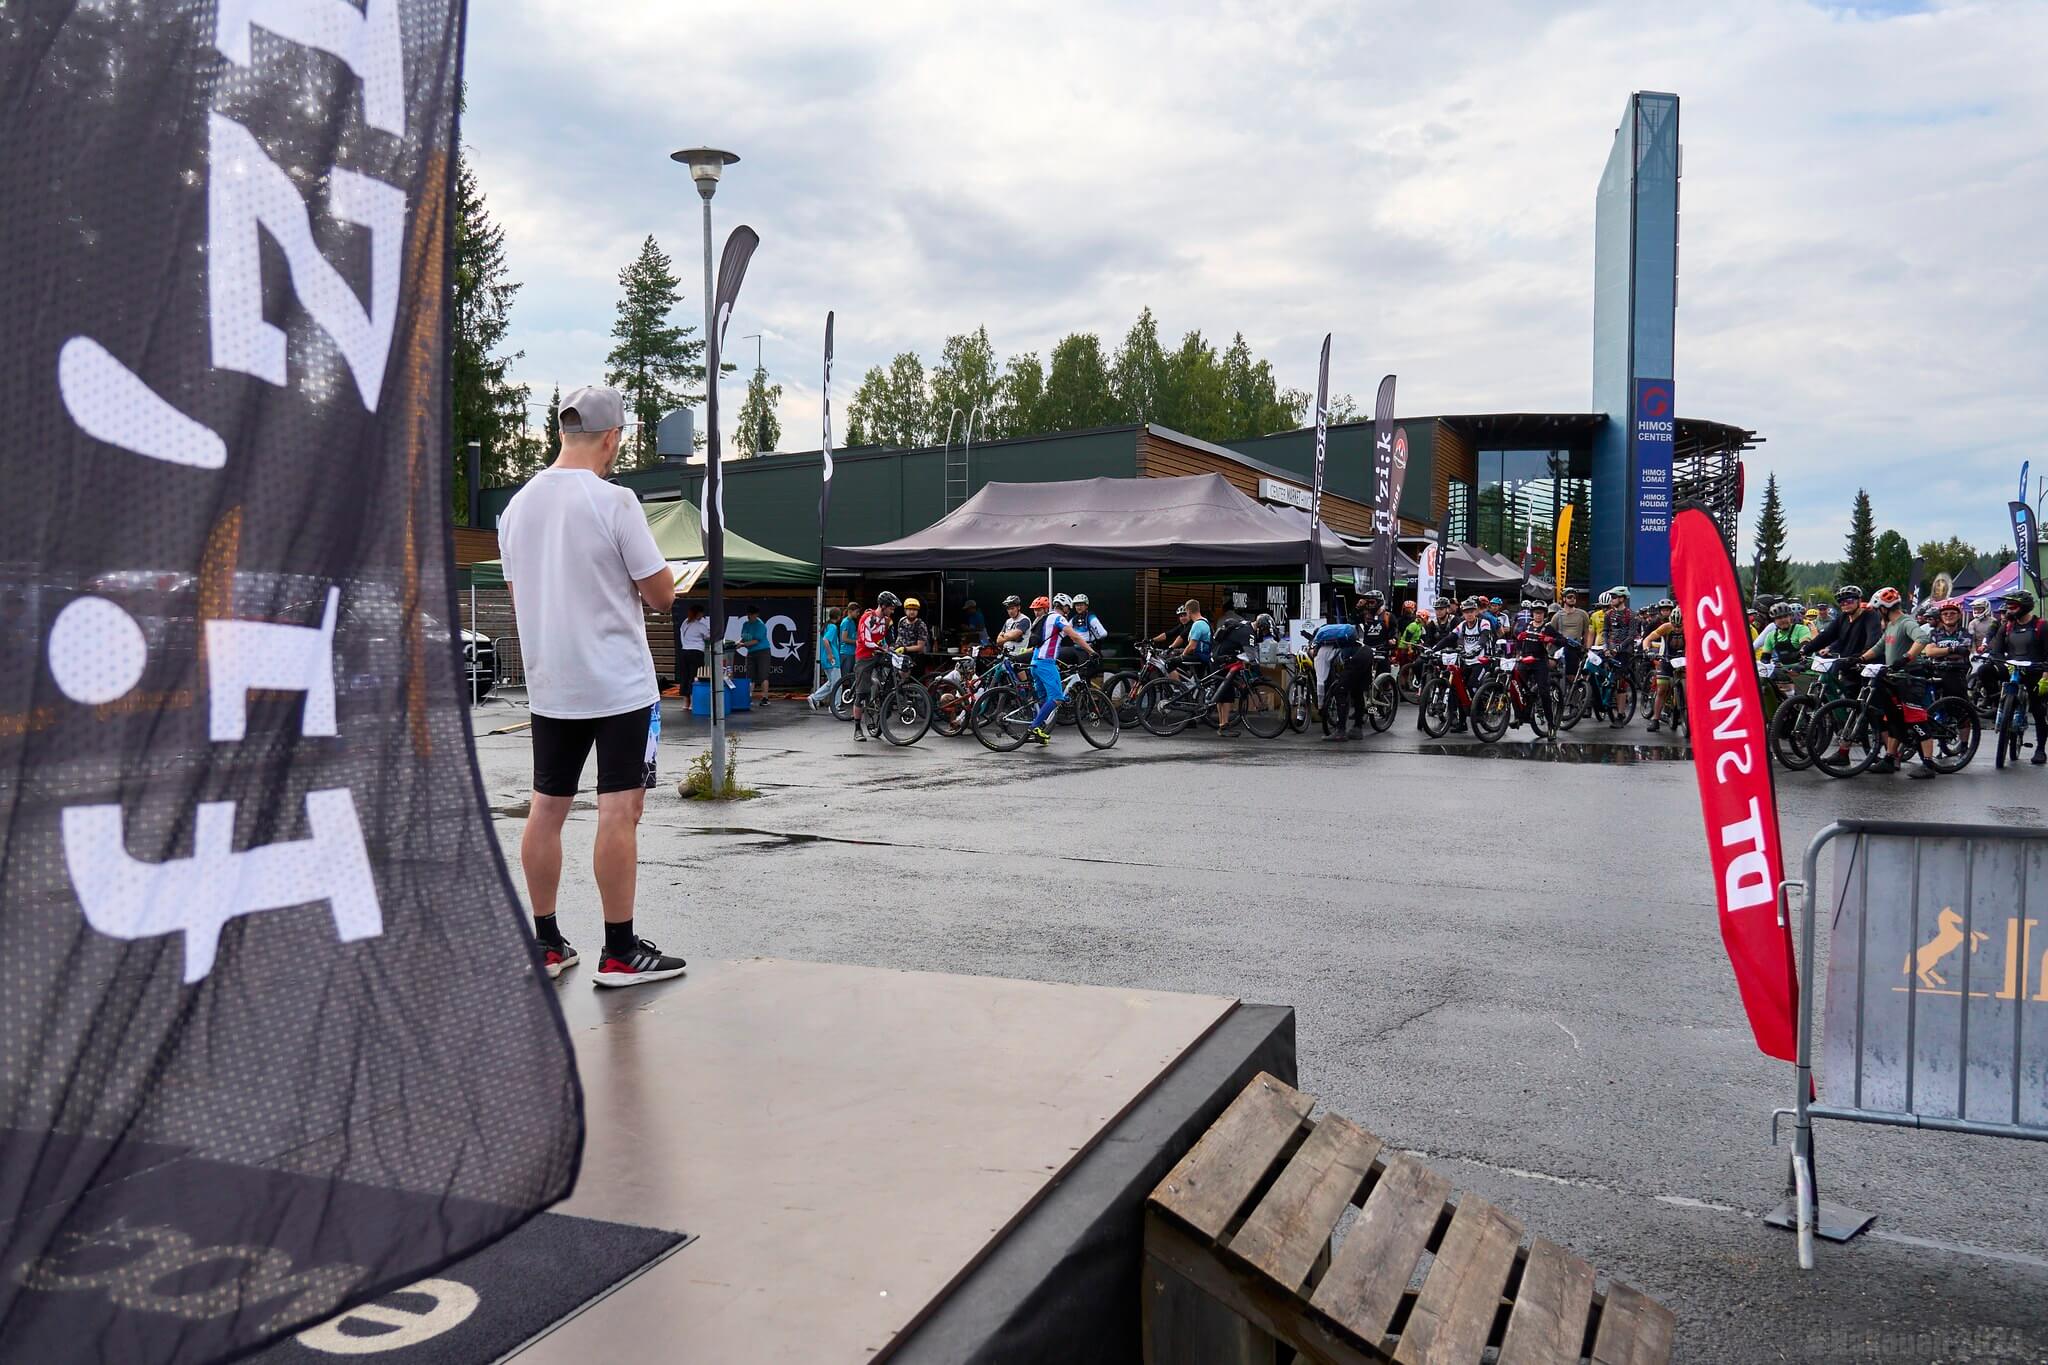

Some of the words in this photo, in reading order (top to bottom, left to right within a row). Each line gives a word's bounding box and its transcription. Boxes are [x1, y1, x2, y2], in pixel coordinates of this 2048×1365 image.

[1638, 421, 1673, 431] HIMOS
[1638, 432, 1673, 441] CENTER
[1640, 500, 1669, 508] HOLIDAY
